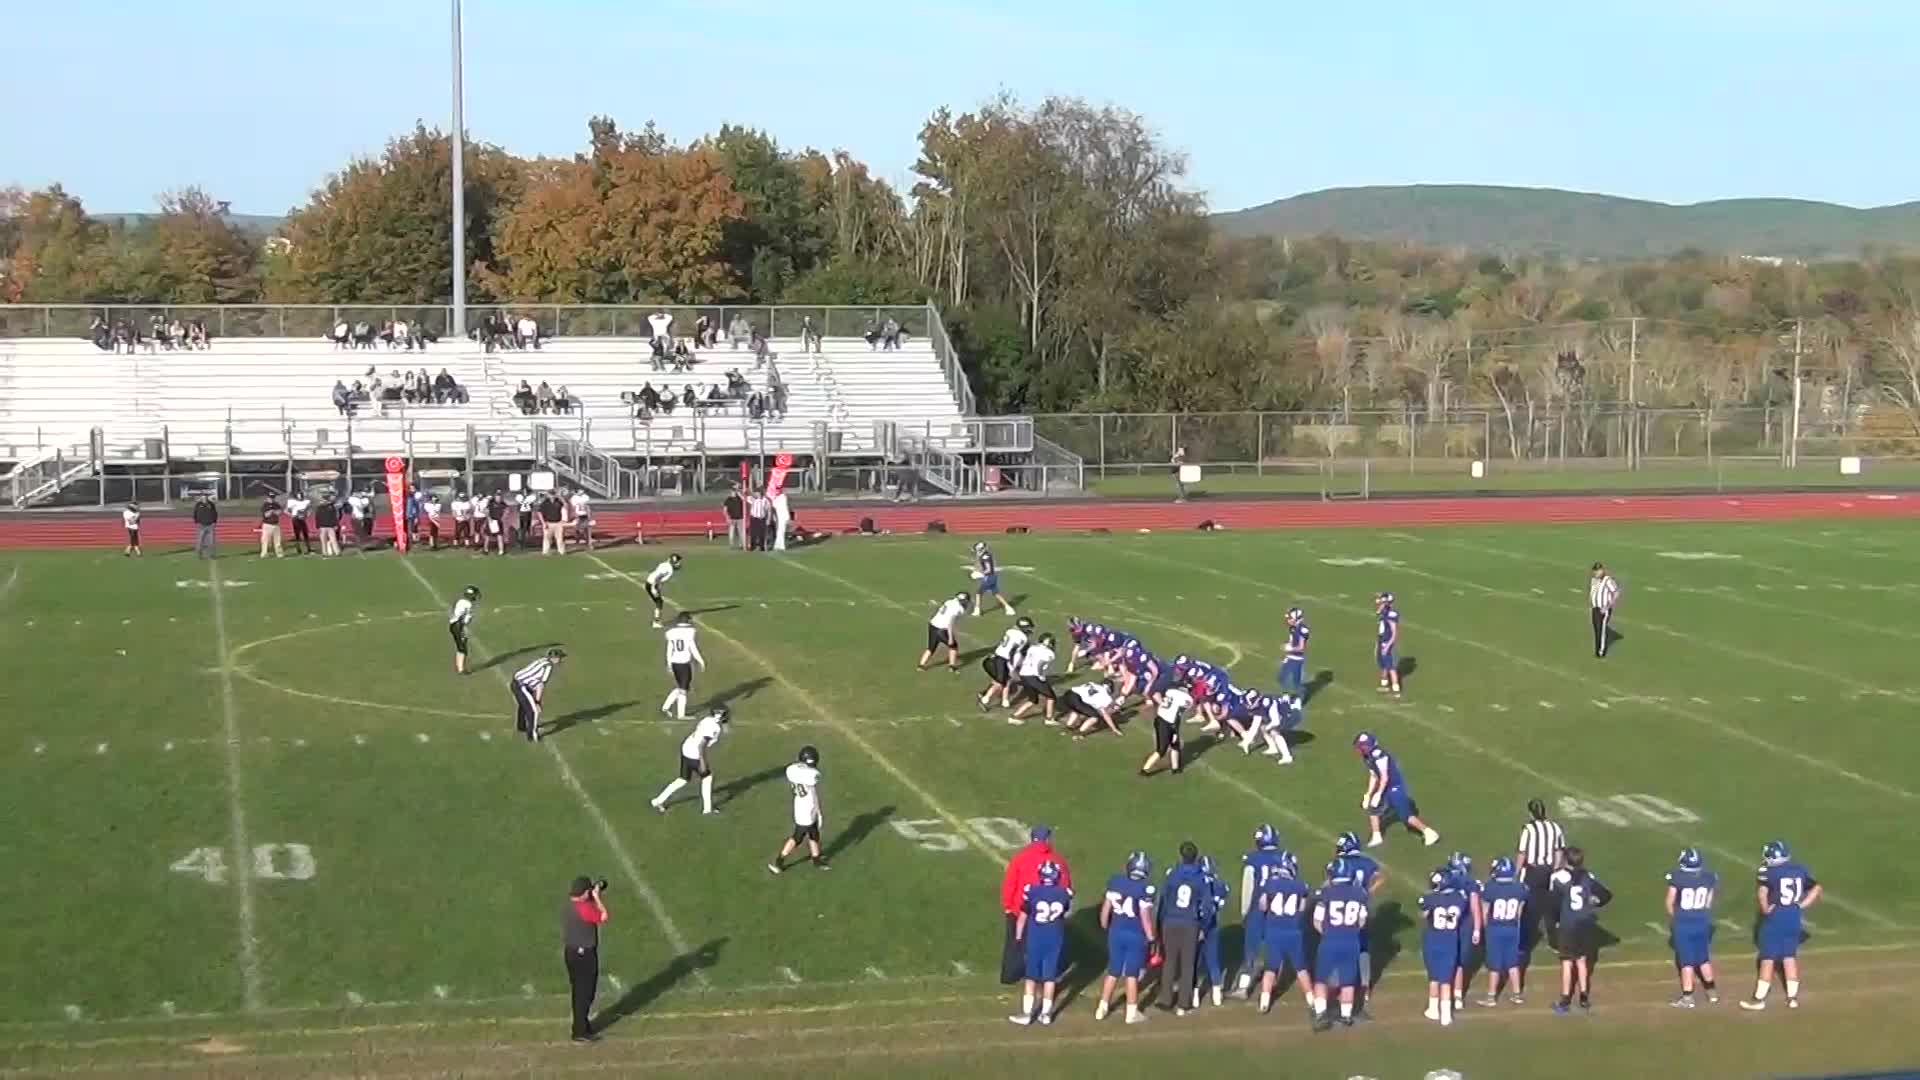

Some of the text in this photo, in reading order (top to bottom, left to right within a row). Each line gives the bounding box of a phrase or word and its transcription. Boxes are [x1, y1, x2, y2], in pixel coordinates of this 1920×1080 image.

[889, 817, 1031, 850] 50
[169, 843, 316, 883] 40
[1105, 890, 1135, 918] 54
[1176, 884, 1192, 908] 9
[1270, 892, 1298, 916] 44
[1569, 885, 1584, 911] 5
[1779, 877, 1803, 906] 51
[1035, 900, 1064, 923] 22
[1329, 900, 1360, 926] 58
[1433, 905, 1461, 930] 63
